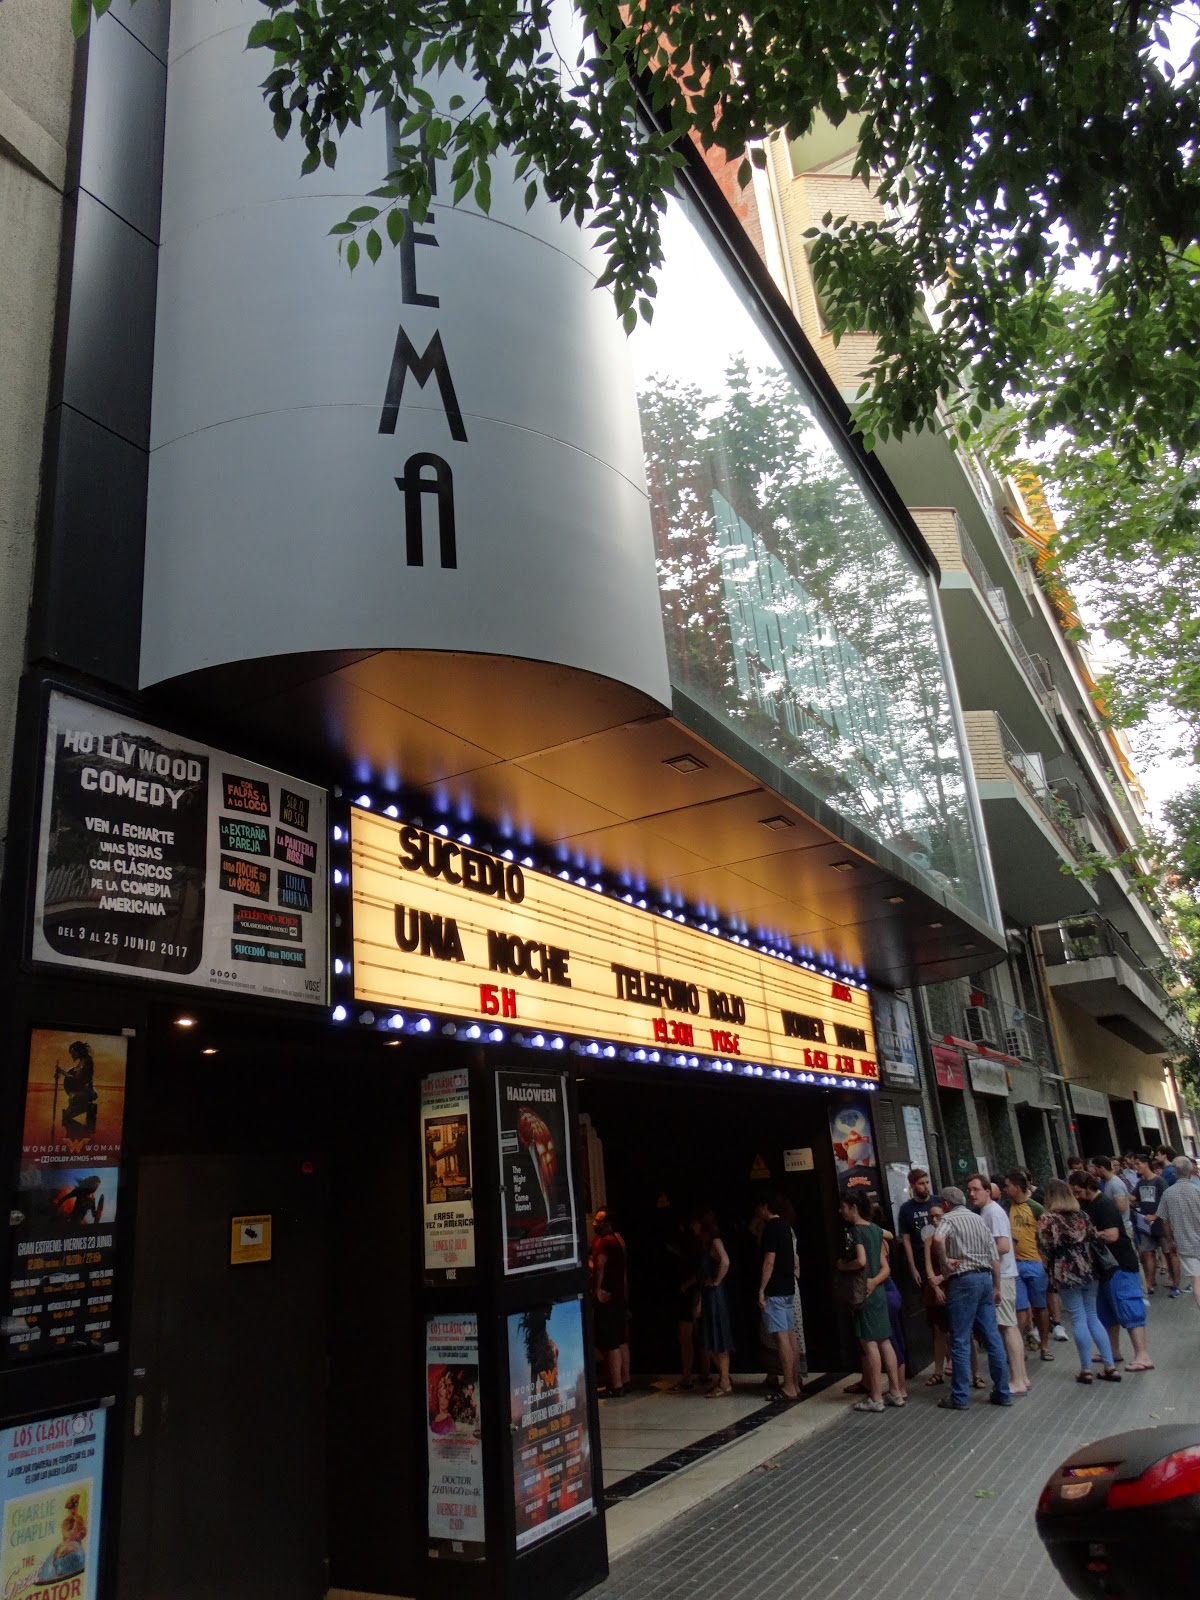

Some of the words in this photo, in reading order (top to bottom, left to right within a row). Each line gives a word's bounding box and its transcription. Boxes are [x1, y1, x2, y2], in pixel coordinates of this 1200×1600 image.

[64, 728, 201, 781] HOLLYWOOD
[81, 767, 185, 810] COMEDY
[228, 784, 259, 800] FALDAS
[241, 781, 253, 789] CON
[234, 799, 243, 807] LO
[243, 798, 268, 812] LOCO
[286, 795, 297, 810] SER
[299, 801, 304, 813] O
[283, 809, 292, 821] NO
[294, 812, 305, 827] SER
[85, 816, 110, 835] VEN
[113, 825, 119, 835] A
[122, 822, 175, 845] ECHARTE
[221, 825, 229, 834] LA
[229, 823, 267, 841] EXTRAÑA
[100, 841, 125, 855] UNAS
[127, 841, 163, 860] RISAS
[229, 836, 260, 852] PAREJA
[277, 835, 284, 845] LA
[284, 834, 314, 858] PANTERA
[286, 847, 304, 866] ROSA
[398, 826, 525, 904] SUCEDIO
[89, 858, 111, 872] CON
[113, 857, 172, 880] CLÁSICOS
[235, 861, 258, 880] NOCHE
[91, 878, 103, 890] DE
[106, 880, 119, 891] LA
[121, 880, 171, 898] COMEDIA
[228, 878, 236, 888] LA
[237, 875, 260, 895] ÓPERA
[285, 874, 306, 892] LUNA
[99, 896, 166, 916] AMERICANA
[282, 889, 309, 908] NUEVA
[58, 926, 75, 938] DEL
[79, 926, 85, 940] 3
[90, 932, 100, 943] AL
[104, 932, 118, 945] 25
[124, 935, 156, 952] JUNIO
[161, 942, 188, 958] 2017
[394, 904, 465, 962] UNA
[487, 929, 572, 988] NOCHE
[234, 944, 266, 957] SUCEDIÓ
[280, 951, 304, 962] NOCHE
[304, 979, 321, 992] VOSE
[611, 962, 700, 1015] TELEFONO
[707, 988, 746, 1026] ROJO
[709, 1028, 741, 1056] VOSE
[506, 1086, 557, 1102] HALLOWEEN
[22, 1145, 67, 1153] WONDER
[512, 1166, 521, 1174] The
[513, 1175, 526, 1184] Night
[18, 1241, 35, 1256] GRAN
[63, 1237, 87, 1251] VIERNES
[88, 1236, 96, 1248] 23
[96, 1235, 112, 1248] JUNIO
[513, 1380, 544, 1396] WONDR
[13, 1425, 32, 1448] LOS
[442, 1475, 471, 1485] DOCTOR
[432, 1485, 464, 1495] ZHIVAGO
[12, 1499, 55, 1527] CHARLIE
[10, 1519, 55, 1547] CHAPLIN
[22, 1554, 35, 1568] THE
